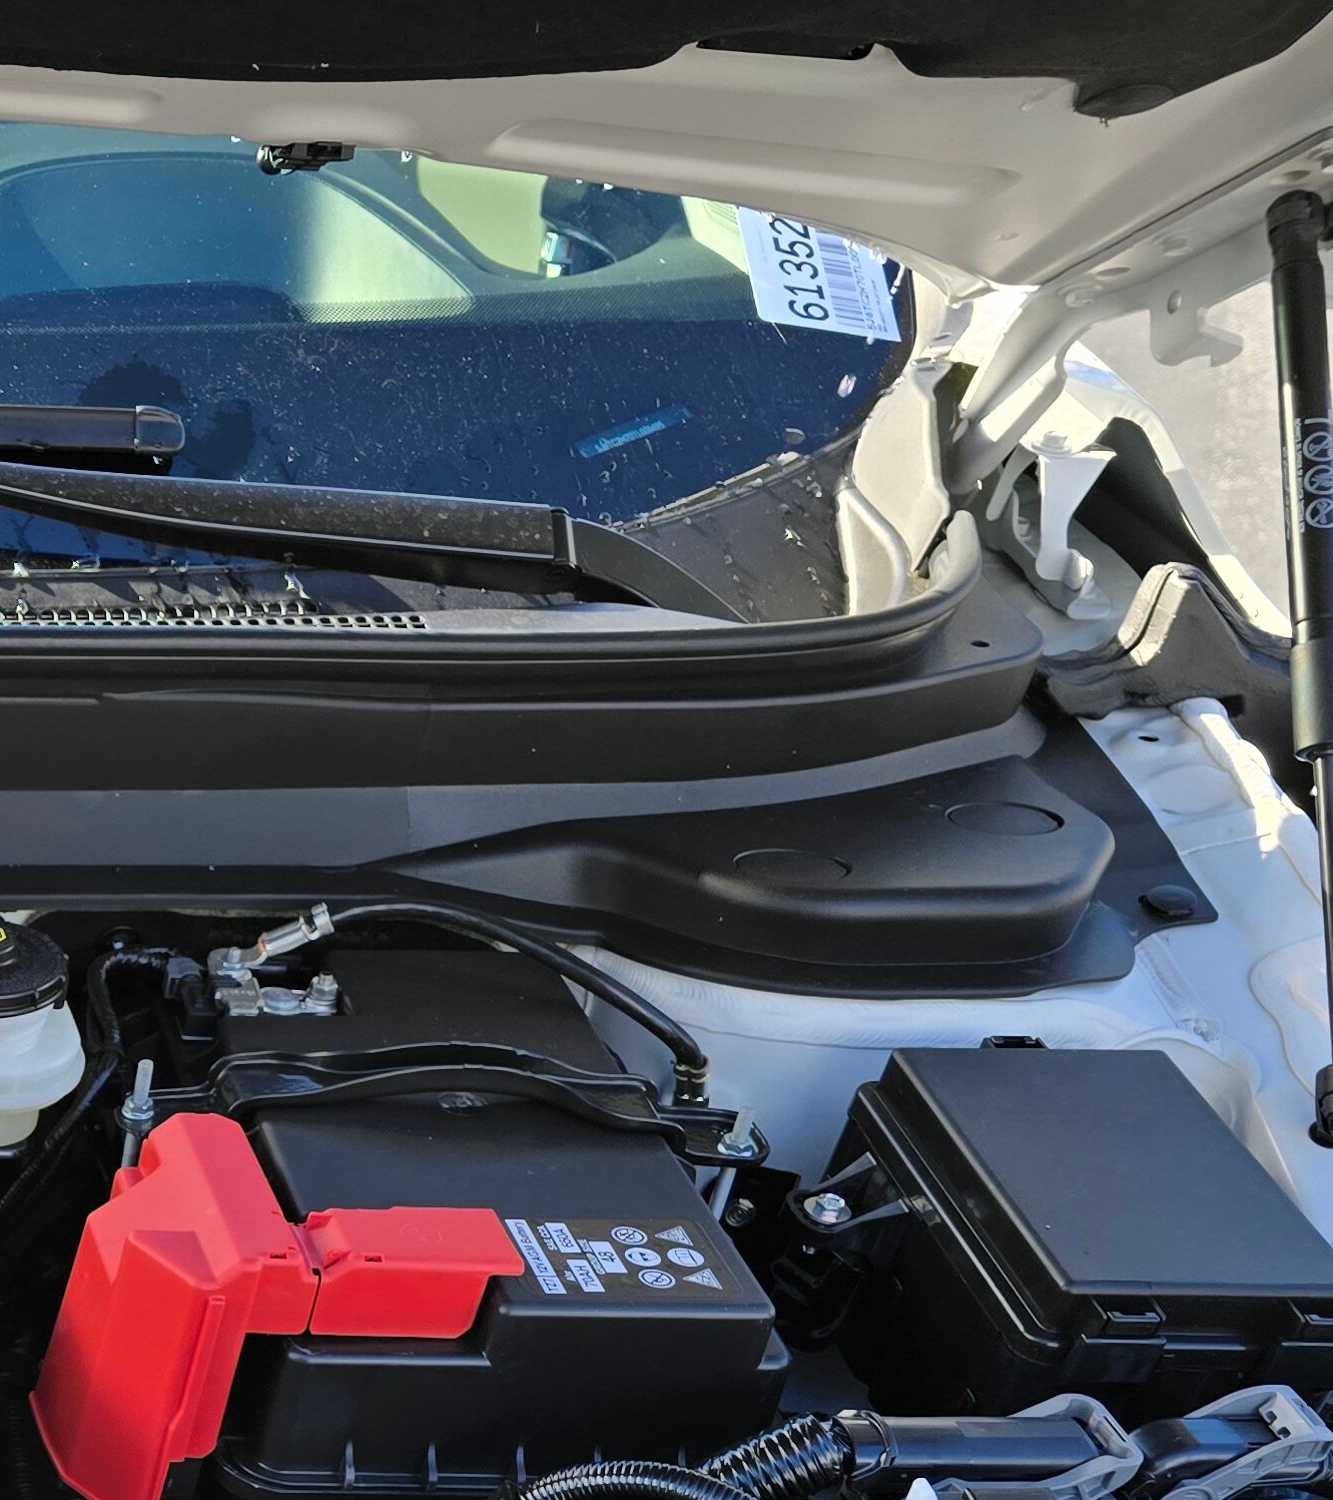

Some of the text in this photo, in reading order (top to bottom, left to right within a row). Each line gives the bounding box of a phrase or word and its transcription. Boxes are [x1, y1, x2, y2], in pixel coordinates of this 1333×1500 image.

[768, 217, 829, 321] 61352
[523, 1244, 543, 1262] AGM
[597, 1250, 617, 1263] 48
